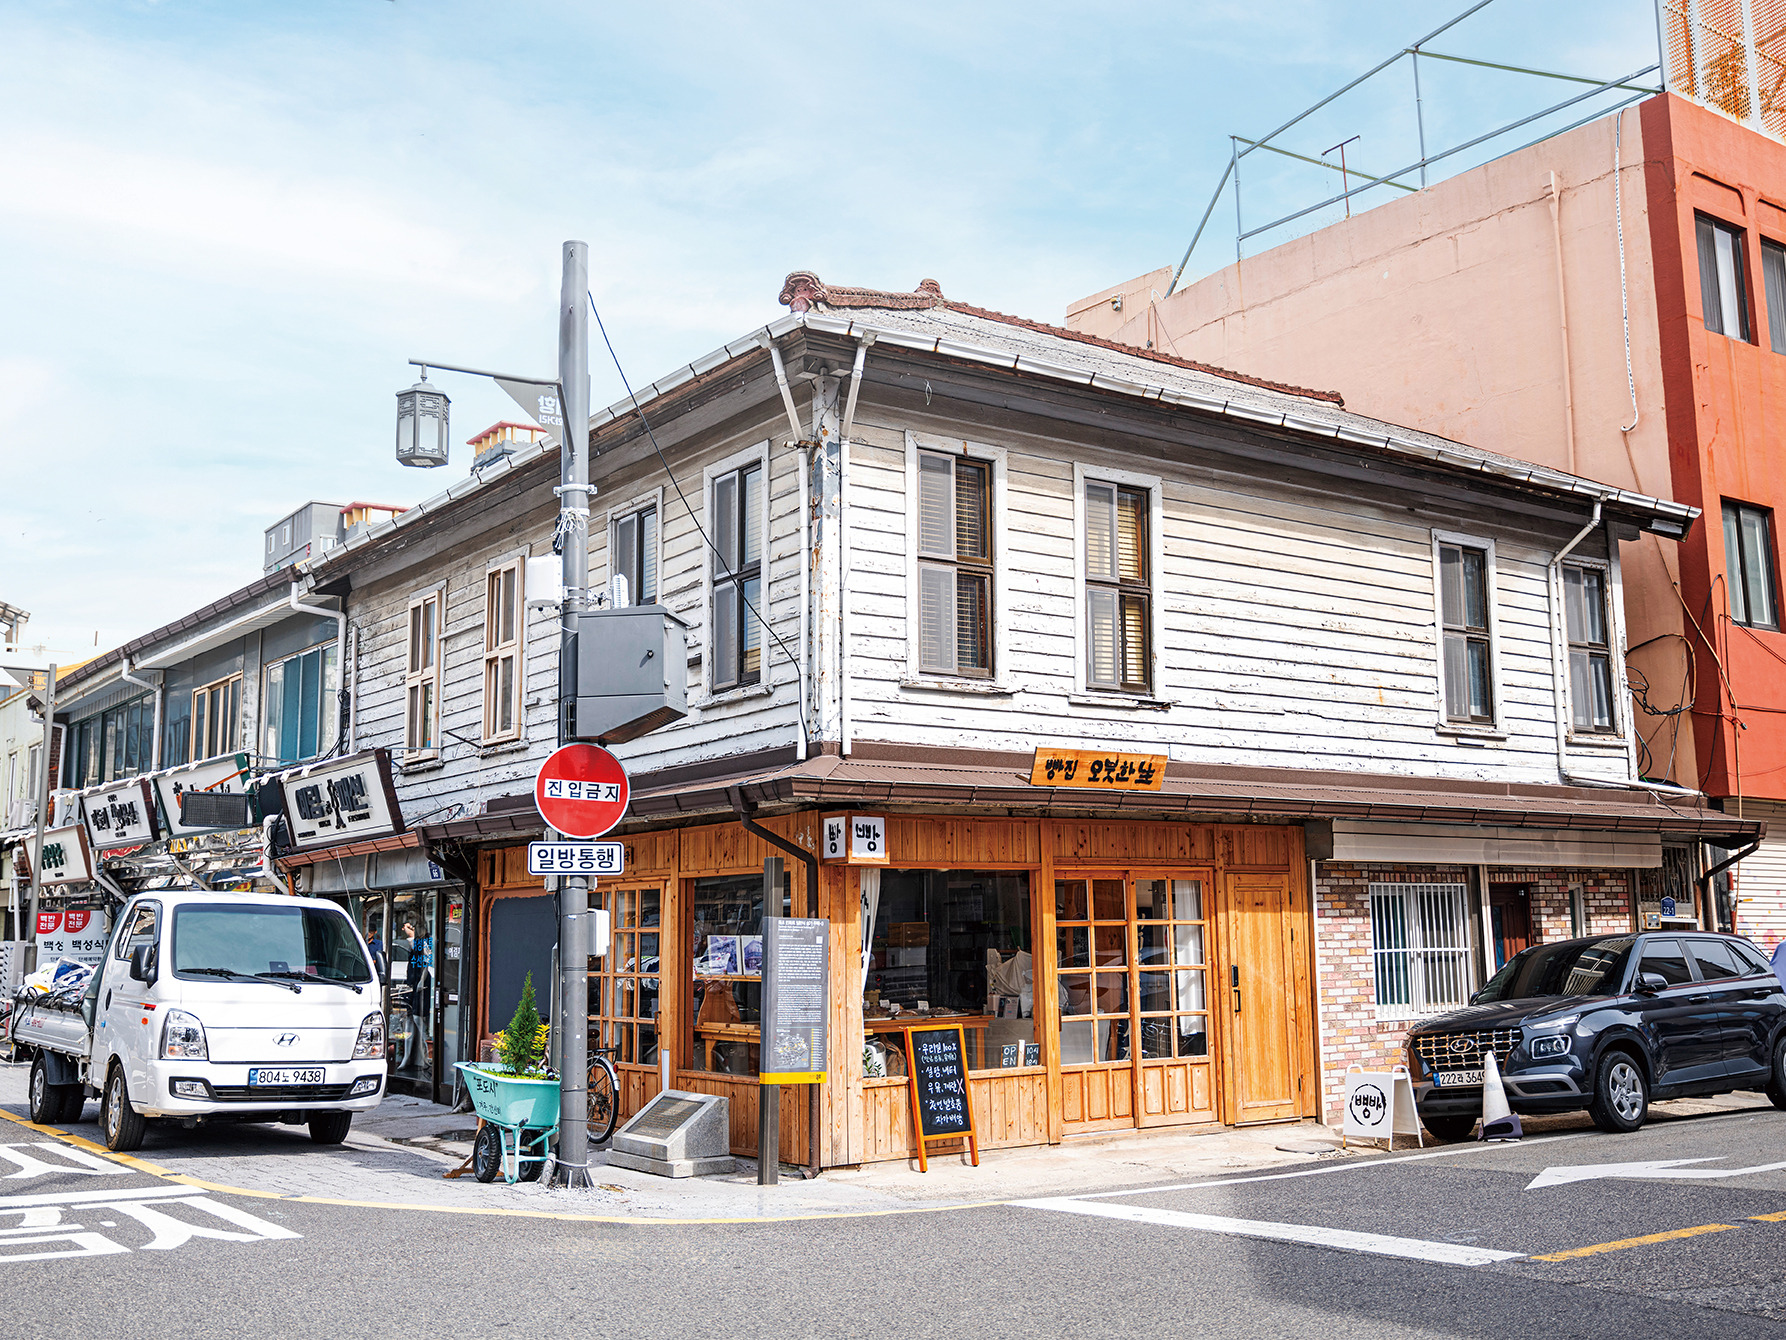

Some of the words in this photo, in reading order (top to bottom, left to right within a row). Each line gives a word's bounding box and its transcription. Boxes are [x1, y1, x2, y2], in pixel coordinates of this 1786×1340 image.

[1045, 758, 1078, 780] 빵집
[547, 780, 619, 802] 진입금지
[537, 848, 614, 869] 일방통행
[40, 922, 55, 930] 전문
[72, 940, 108, 951] 백성식
[259, 1071, 289, 1083] 804노
[293, 1070, 321, 1082] 9438
